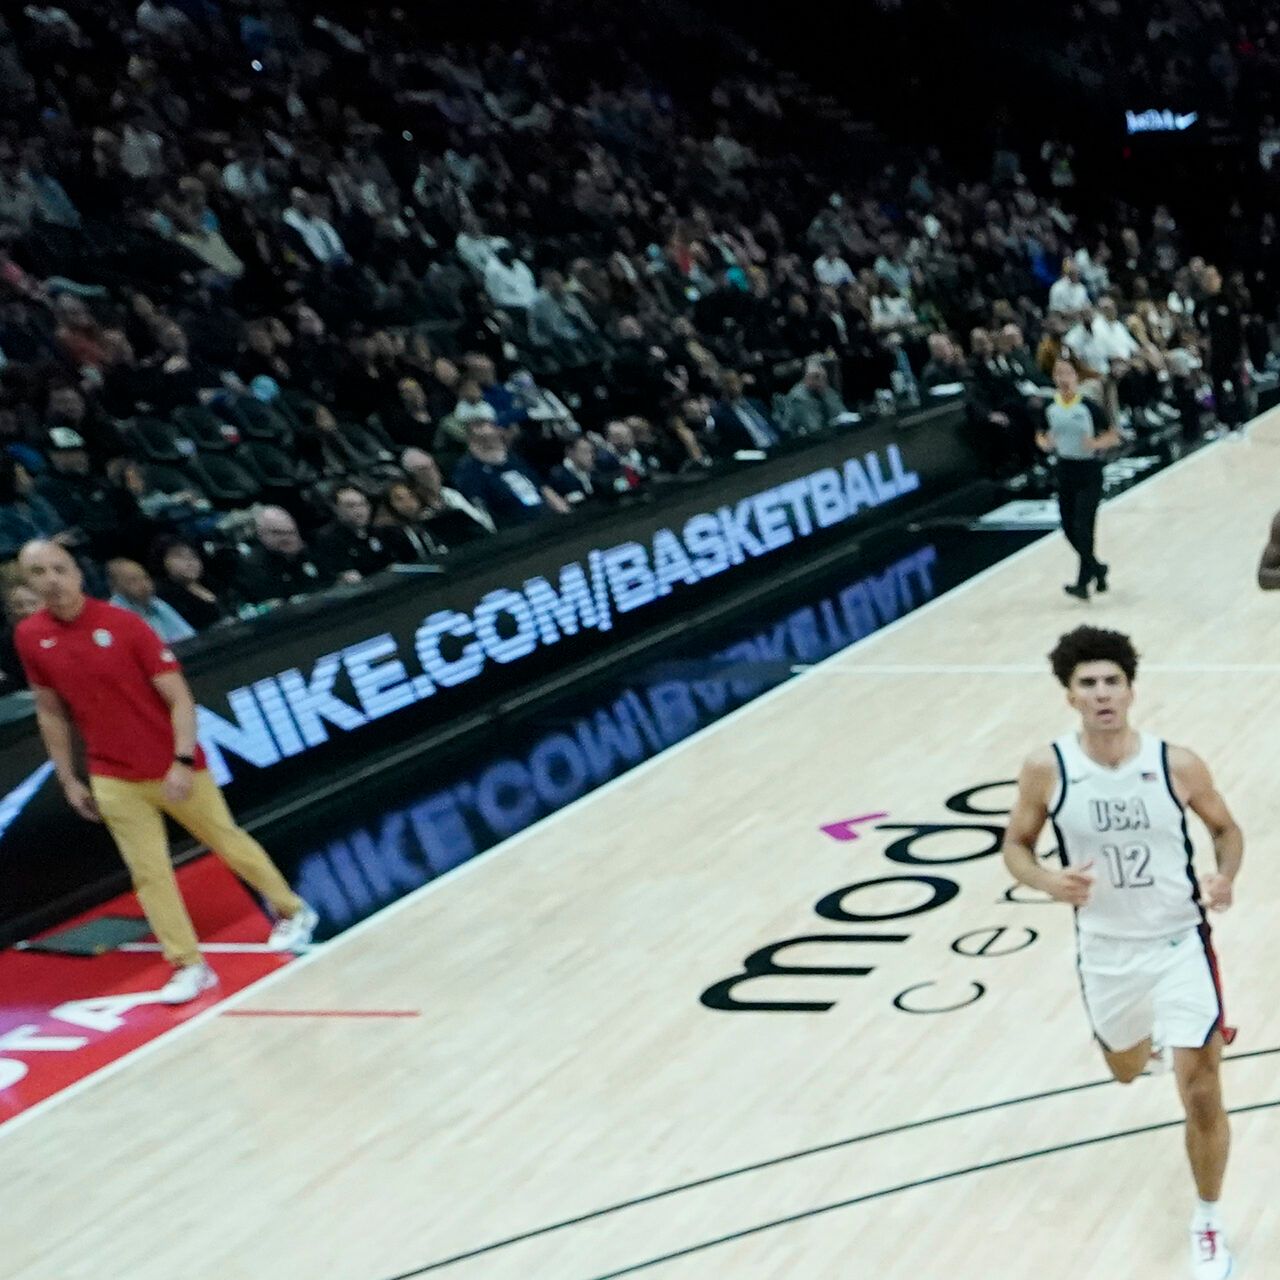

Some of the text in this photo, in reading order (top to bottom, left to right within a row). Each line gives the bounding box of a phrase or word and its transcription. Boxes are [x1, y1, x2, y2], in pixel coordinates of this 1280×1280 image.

[194, 443, 920, 787] NIKE.COM/BASKETBALL
[1088, 797, 1150, 833] USA
[1102, 842, 1154, 889] 12
